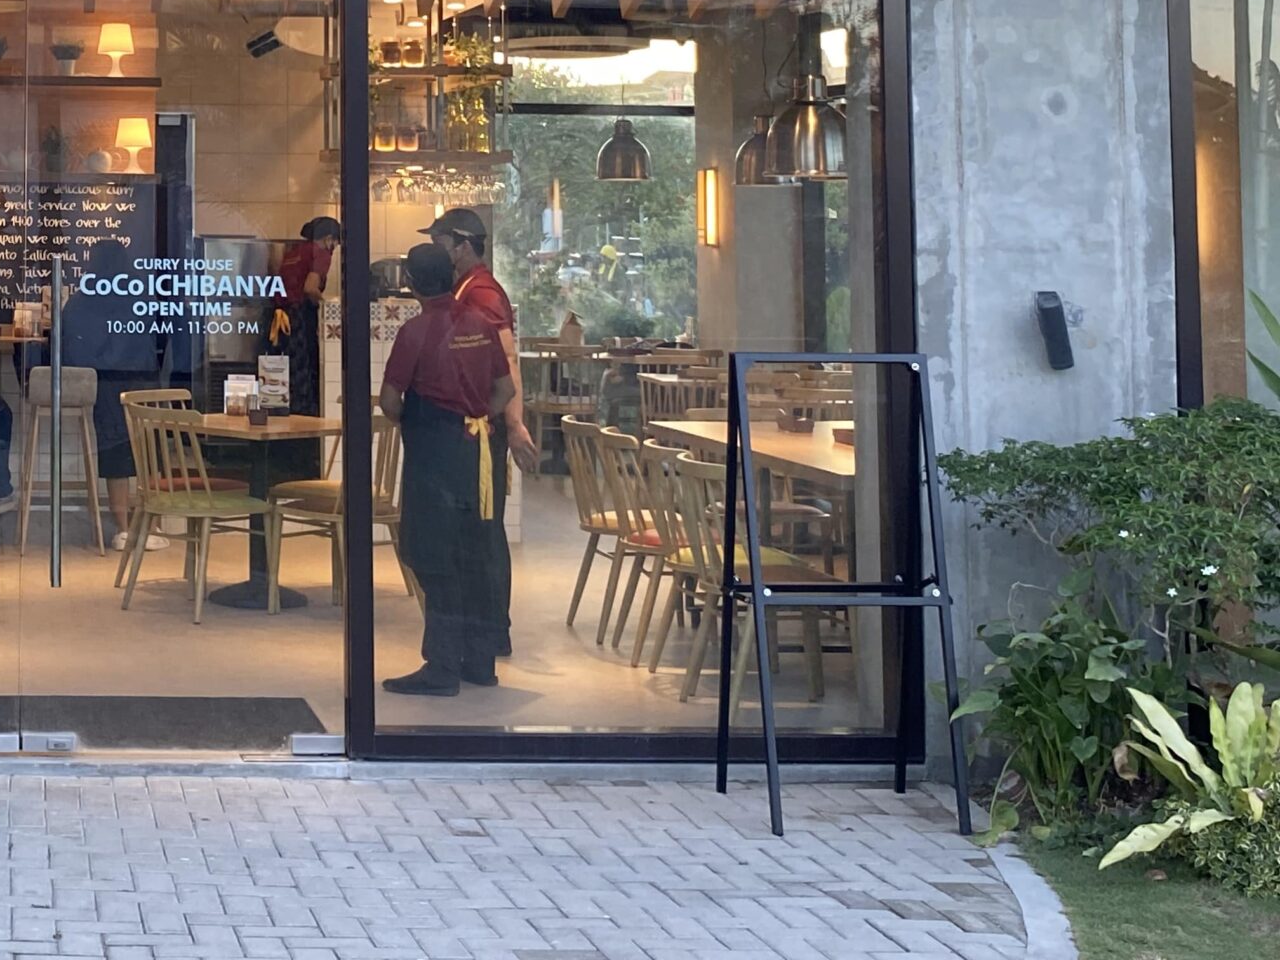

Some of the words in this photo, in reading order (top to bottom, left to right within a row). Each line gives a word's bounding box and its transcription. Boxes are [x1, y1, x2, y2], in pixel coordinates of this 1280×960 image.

[29, 185, 48, 194] our
[53, 184, 101, 195] delicious
[106, 185, 135, 198] curry
[38, 201, 77, 212] service
[82, 200, 112, 212] Now
[115, 202, 136, 212] we
[37, 216, 71, 228] stores
[75, 219, 100, 228] over
[104, 216, 122, 228] the
[27, 235, 48, 244] we
[52, 235, 71, 244] are
[133, 258, 180, 270] CURRY
[184, 259, 233, 271] HOUSE
[132, 301, 184, 316] OPEN
[189, 302, 232, 317] TIME
[106, 320, 145, 334] 10:00
[149, 321, 174, 335] AM
[238, 322, 259, 335] PM
